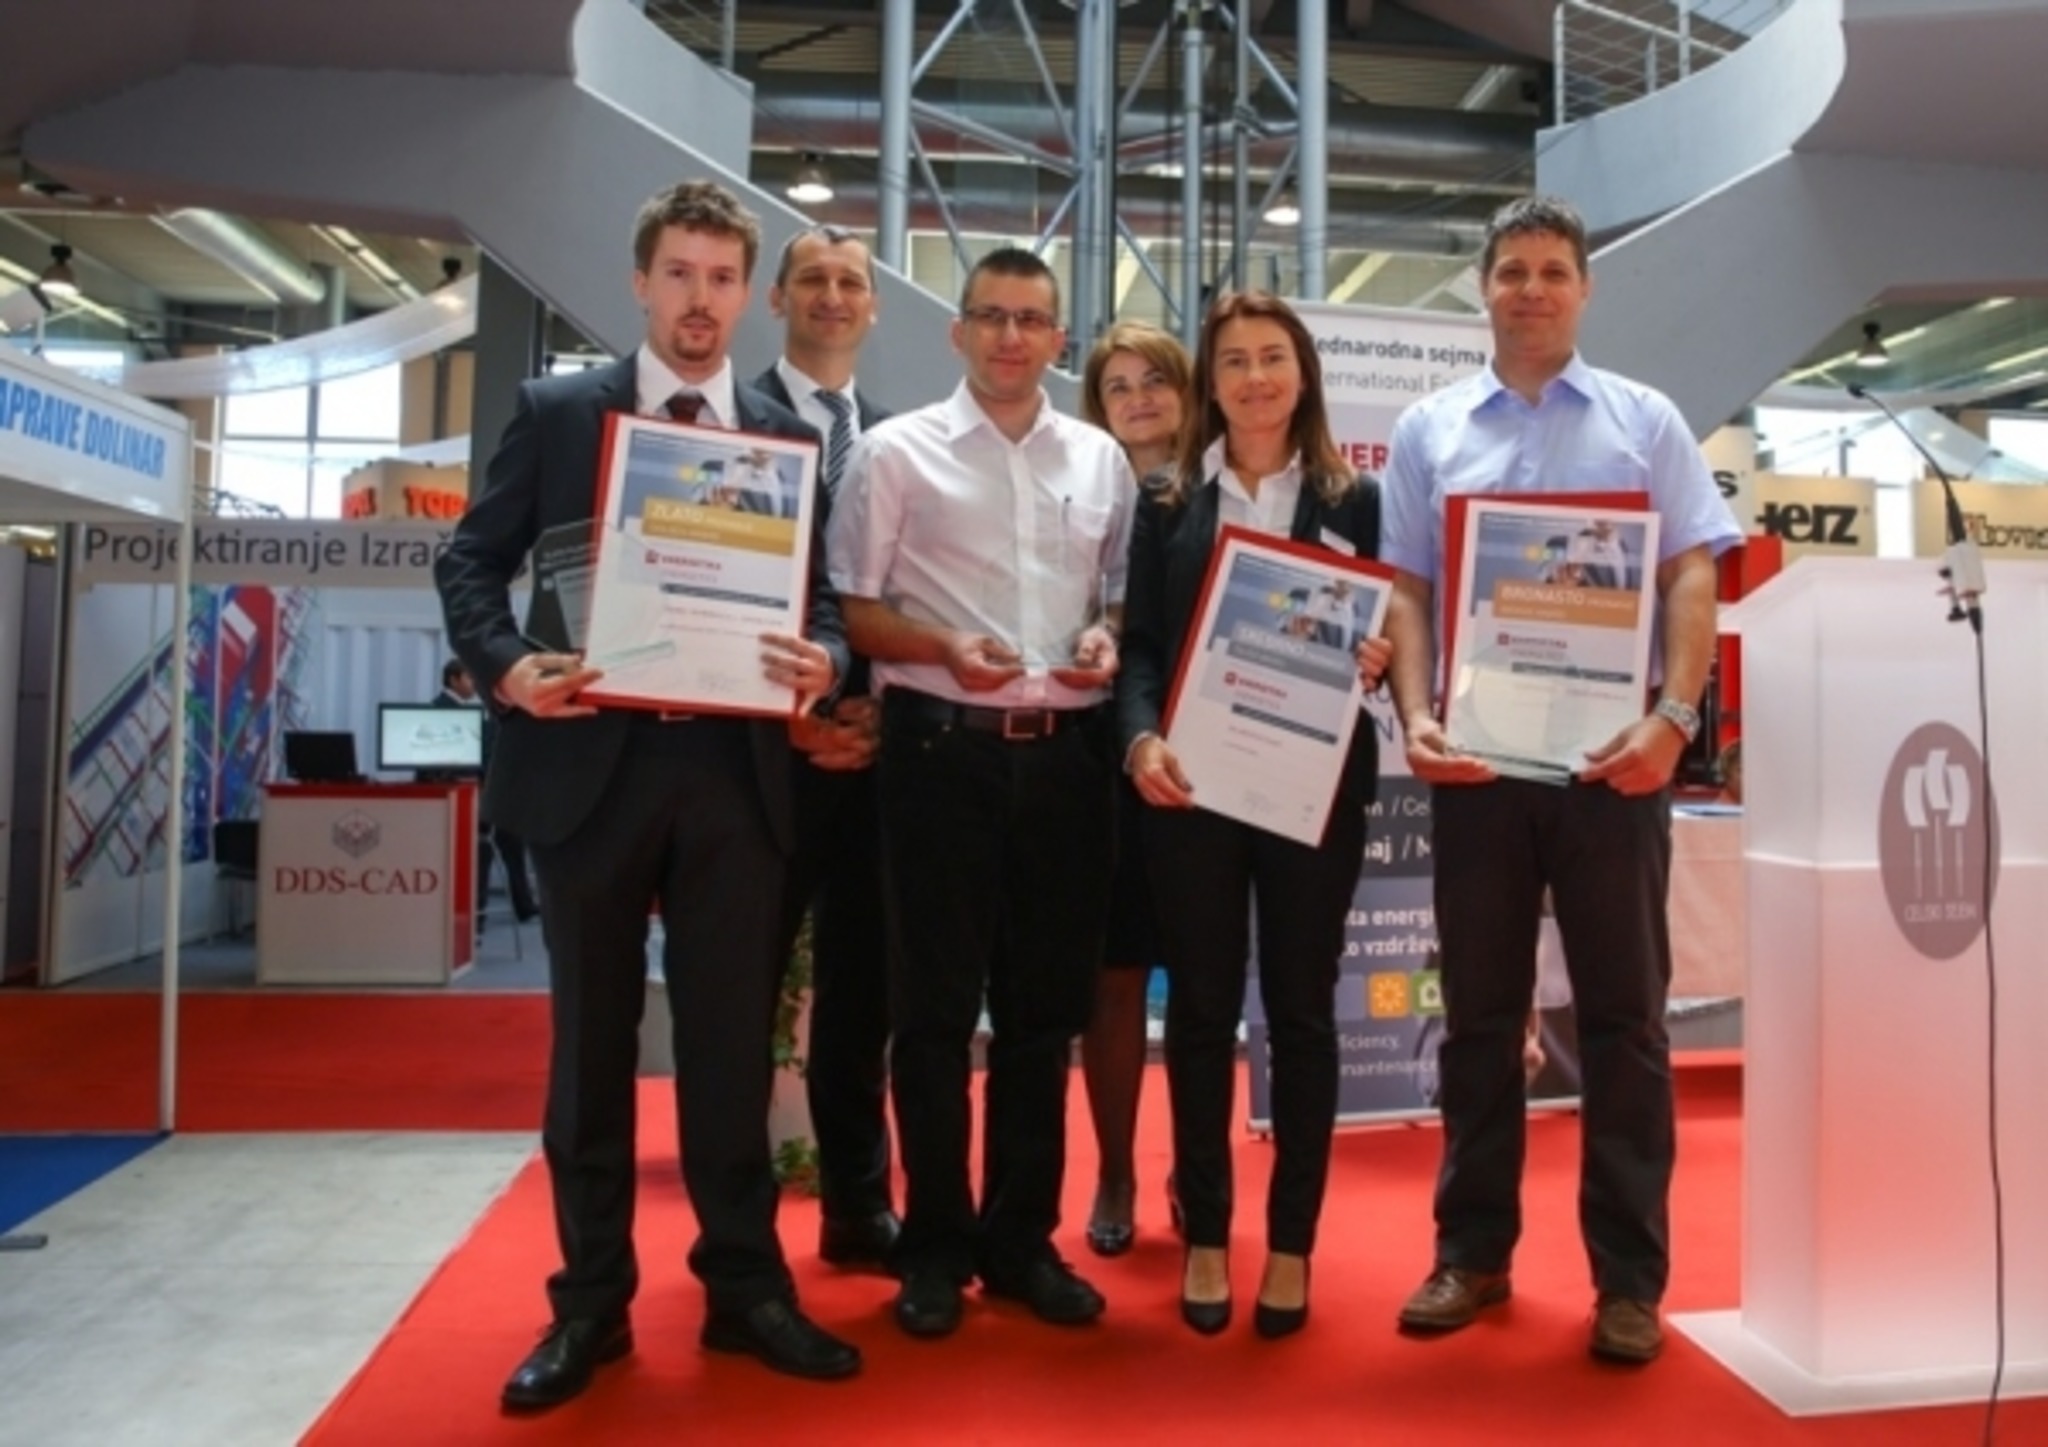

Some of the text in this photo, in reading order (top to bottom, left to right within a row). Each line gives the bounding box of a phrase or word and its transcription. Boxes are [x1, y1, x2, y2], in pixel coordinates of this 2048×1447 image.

[1428, 344, 1486, 368] sejma
[83, 408, 166, 480] DOLINAR
[84, 527, 347, 571] Projektiranje
[275, 867, 439, 894] DDS-CAD
